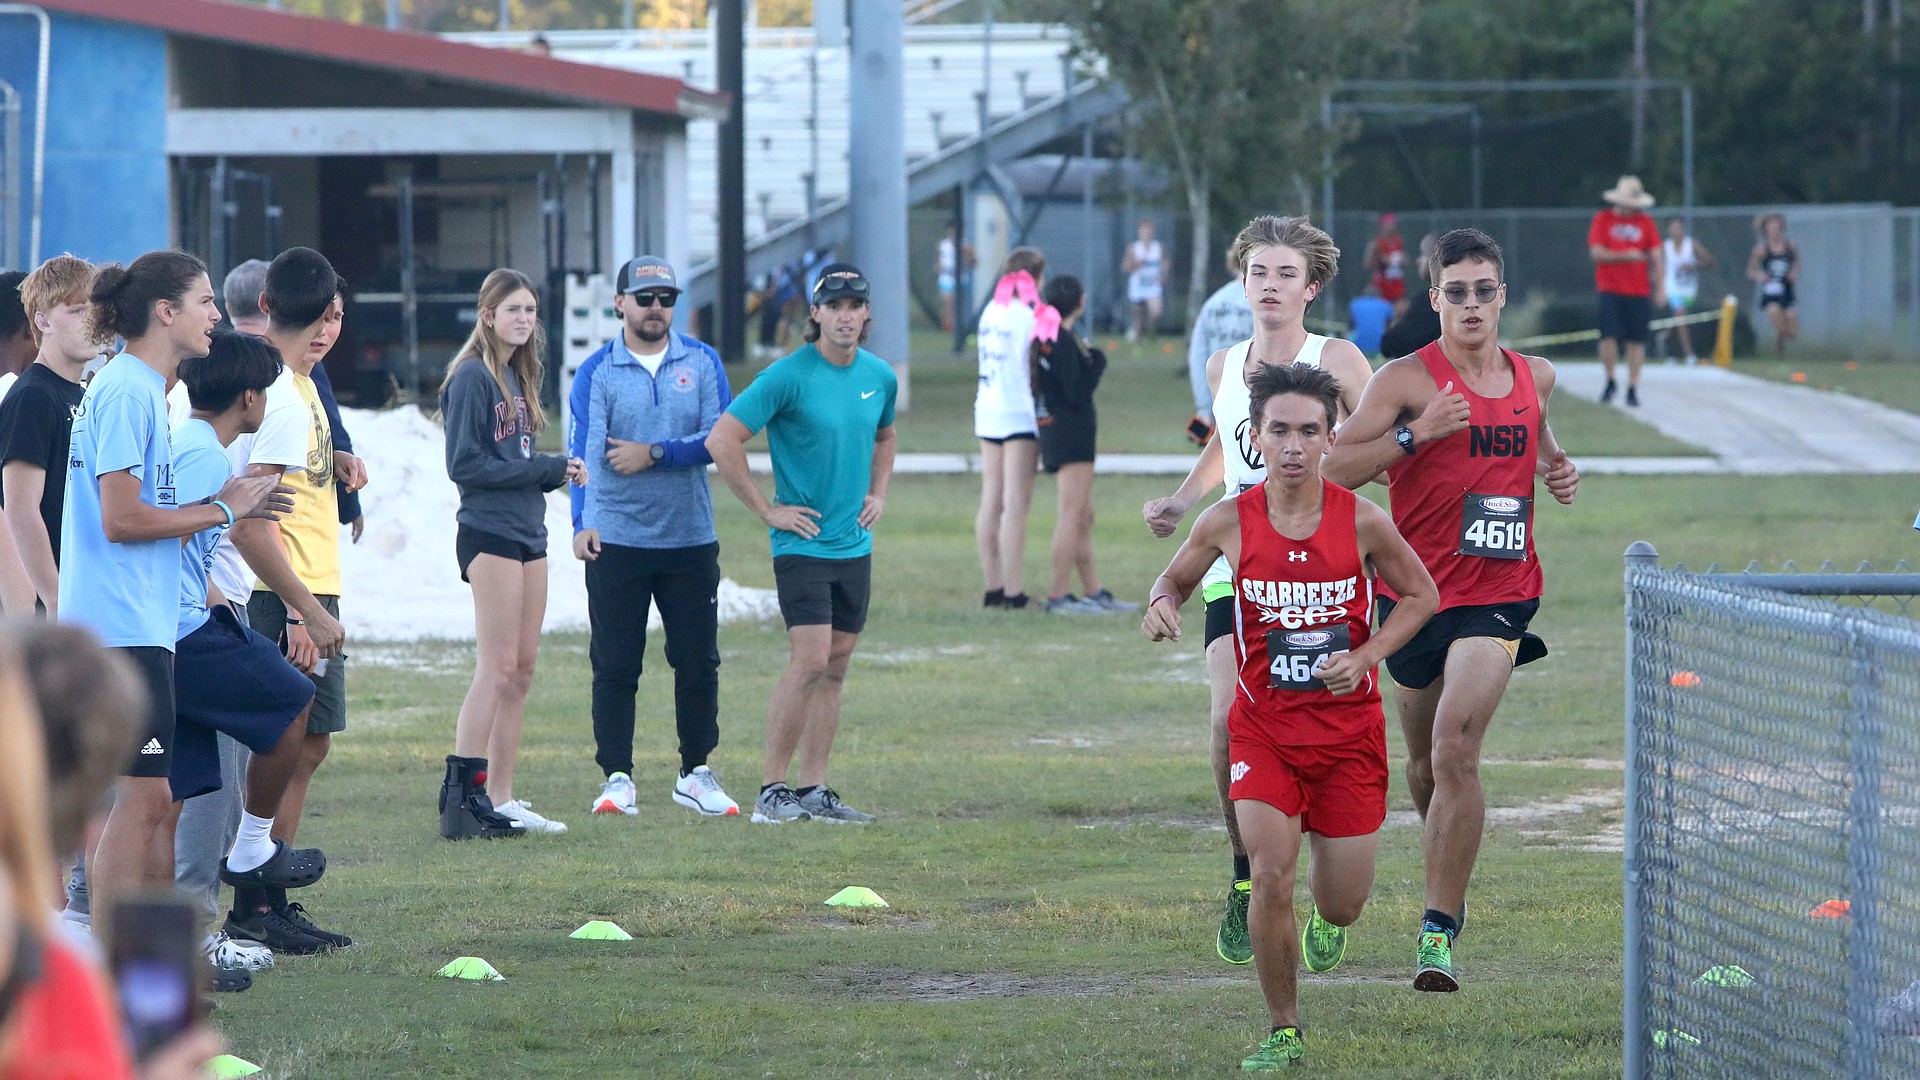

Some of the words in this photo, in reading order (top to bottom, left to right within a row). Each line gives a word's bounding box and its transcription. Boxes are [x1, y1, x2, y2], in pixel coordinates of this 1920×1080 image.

[1469, 424, 1528, 458] NSB
[1465, 519, 1526, 550] 4619
[1242, 576, 1357, 608] SEABREEZE
[1270, 649, 1350, 682] 464
